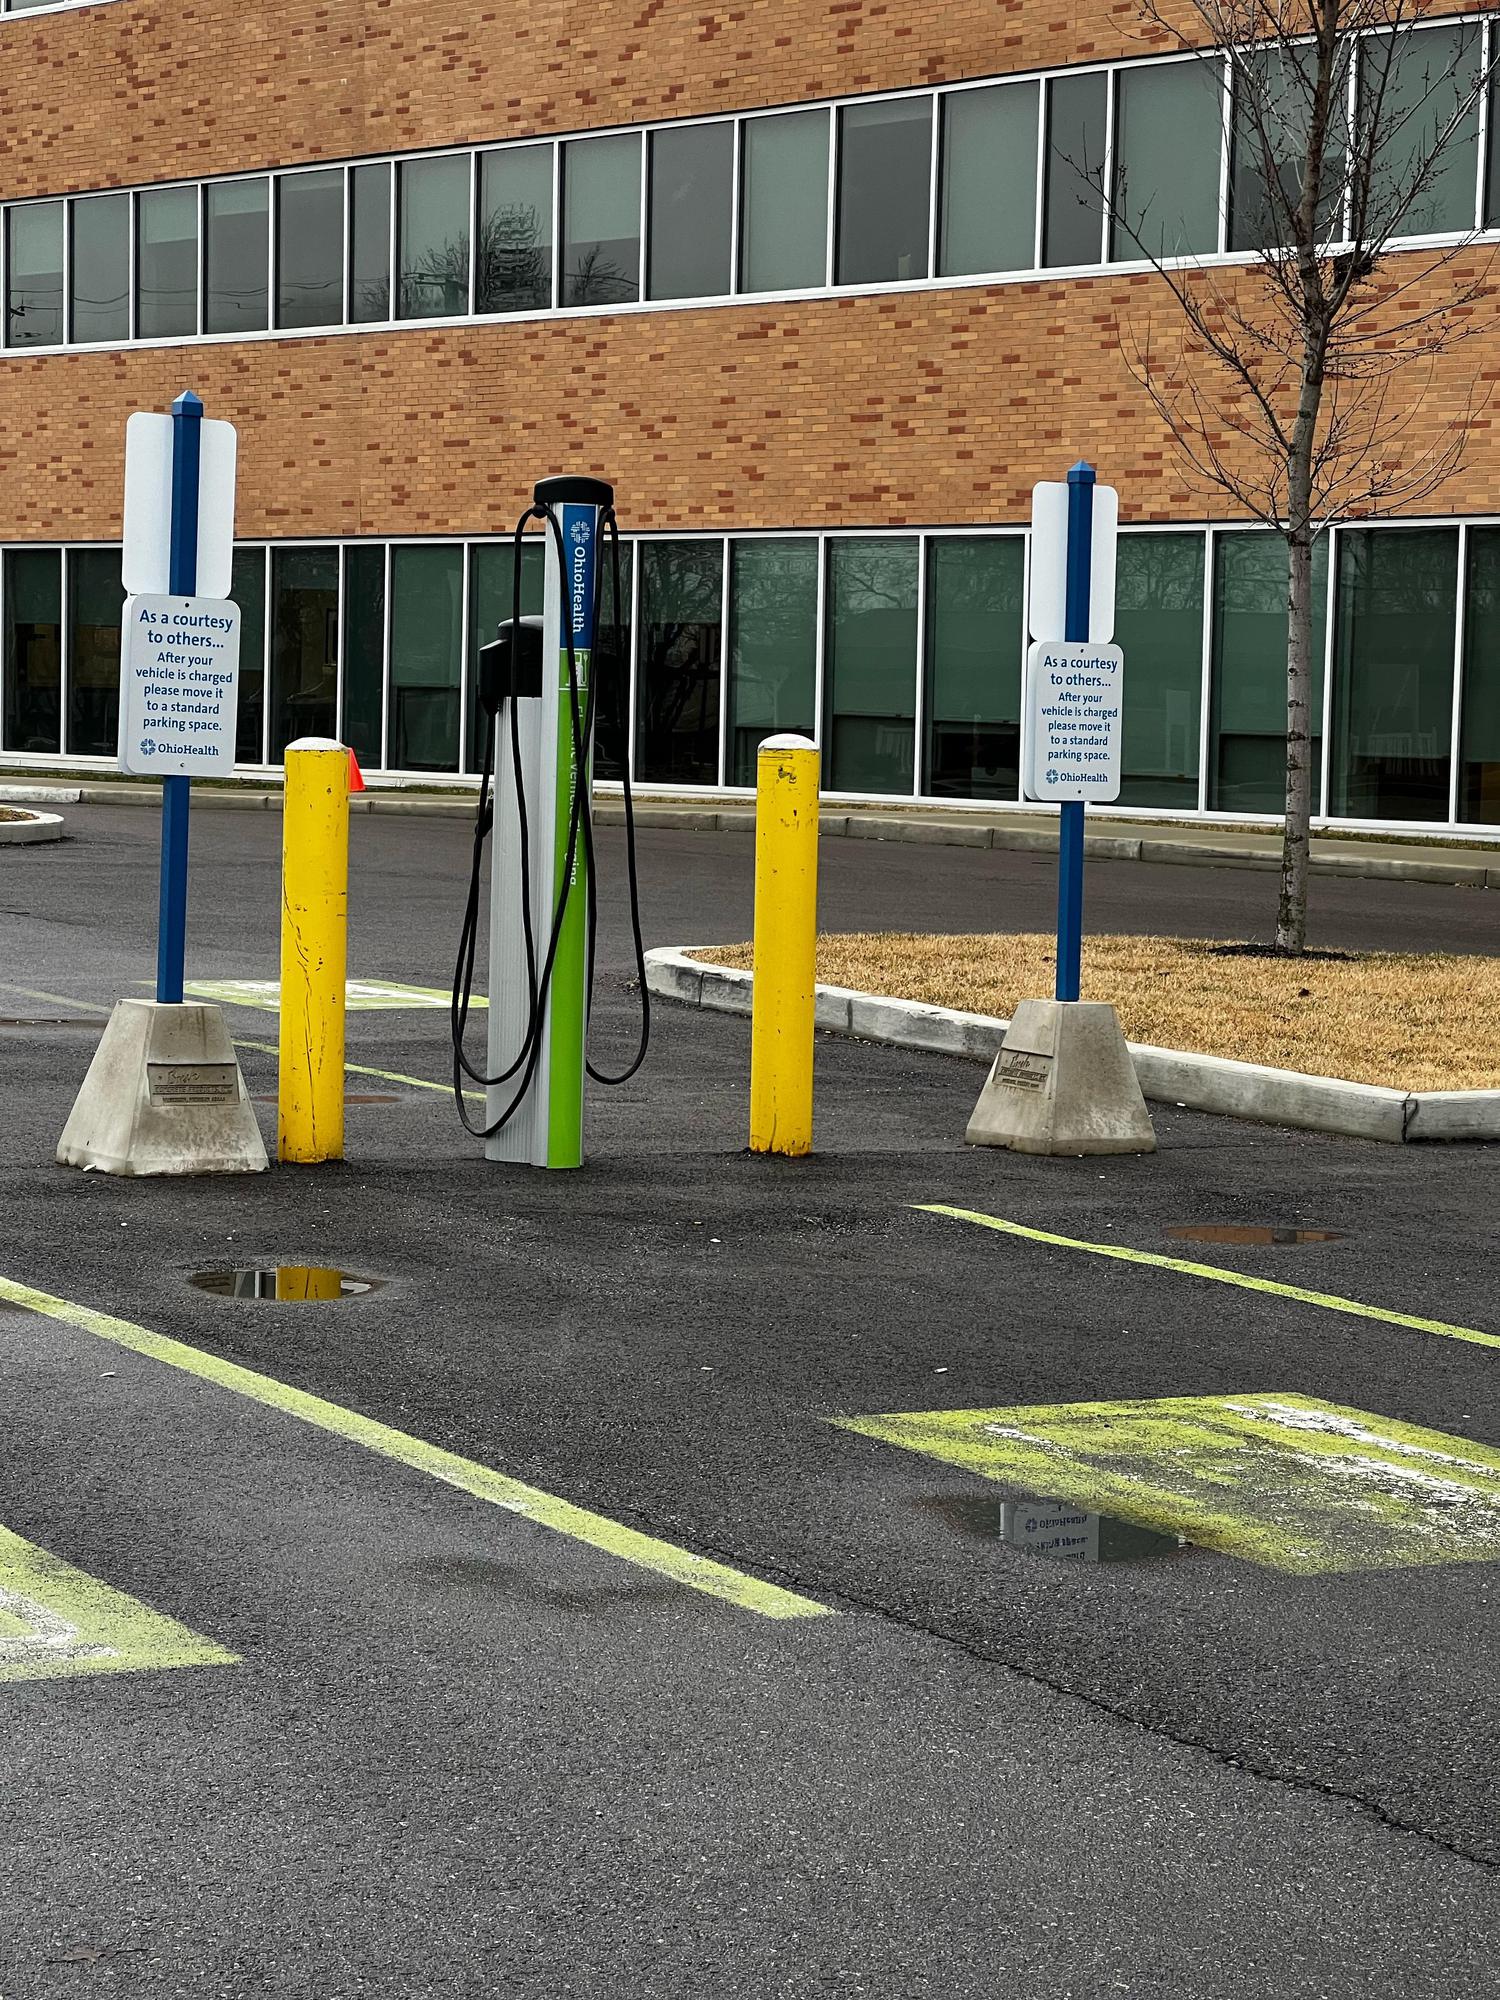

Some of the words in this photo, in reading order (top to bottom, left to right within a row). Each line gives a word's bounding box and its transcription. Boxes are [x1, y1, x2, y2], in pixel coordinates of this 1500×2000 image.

[573, 547, 585, 633] OhioHealth
[140, 610, 156, 623] As
[161, 614, 168, 624] a
[174, 614, 233, 632] courtesy
[148, 630, 162, 643] to
[167, 632, 224, 648] others...
[157, 652, 185, 663] After
[188, 655, 213, 667] your
[1044, 656, 1057, 667] As
[1061, 659, 1067, 667] a
[1071, 658, 1117, 673] courtesy
[136, 668, 174, 679] vehicle
[178, 669, 185, 680] is
[189, 671, 232, 685] charged
[1051, 673, 1063, 685] to
[1066, 674, 1111, 687] others...
[144, 684, 179, 697] please
[183, 689, 212, 697] move
[216, 688, 223, 698] it
[1059, 692, 1080, 702] After
[1083, 695, 1102, 705] your
[147, 701, 158, 711] to
[162, 702, 167, 711] a
[171, 702, 219, 714] standard
[1042, 706, 1072, 716] vehicle
[1075, 707, 1081, 716] is
[1084, 707, 1118, 720] charged
[143, 718, 185, 731] parking
[189, 720, 222, 732] space.
[1048, 720, 1076, 732] please
[1079, 723, 1102, 731] move
[1105, 722, 1111, 732] it
[1051, 735, 1060, 744] to
[1070, 736, 1108, 746] standard
[159, 744, 219, 756] OhioHealth
[1048, 750, 1082, 762] parking
[1084, 752, 1110, 762] space.
[1060, 772, 1108, 782] OhioHealth
